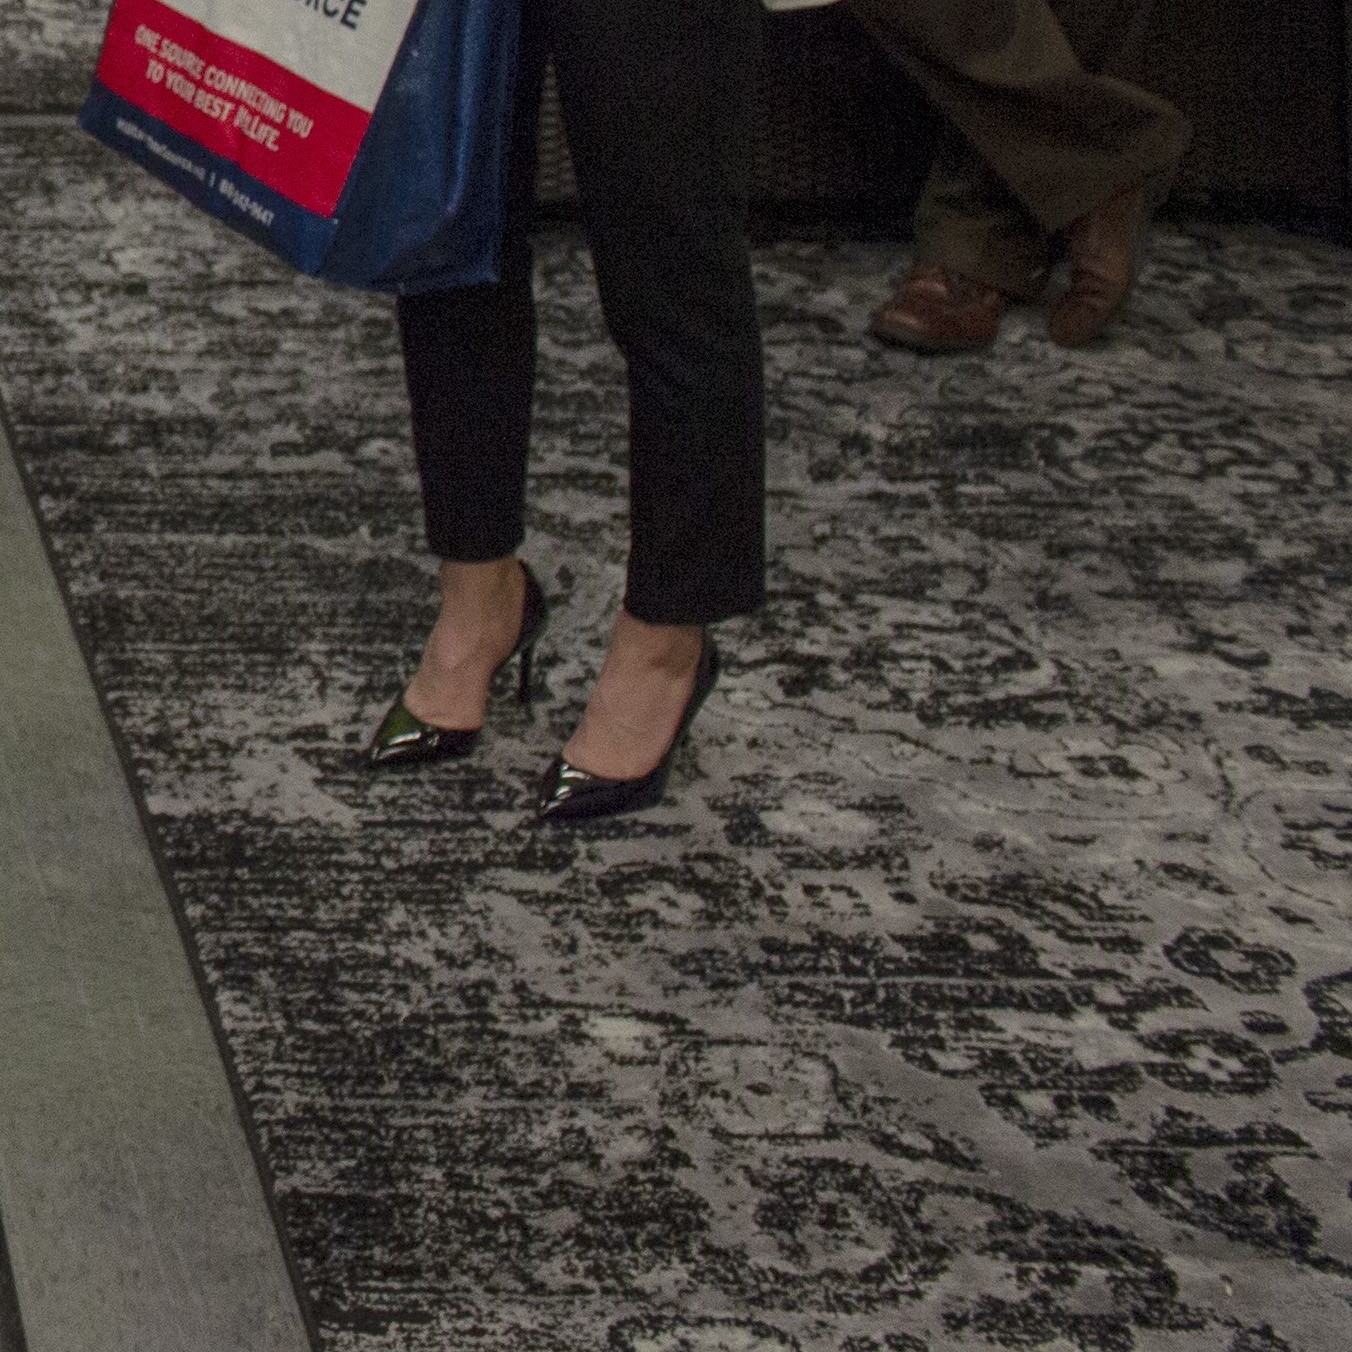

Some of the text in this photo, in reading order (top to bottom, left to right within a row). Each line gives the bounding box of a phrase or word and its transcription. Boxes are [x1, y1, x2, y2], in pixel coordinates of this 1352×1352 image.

[134, 23, 314, 139] ONE SOURCE CONNECTING YOU
[146, 58, 166, 84] TO
[164, 68, 197, 103] YOUR
[193, 88, 236, 122] BEST
